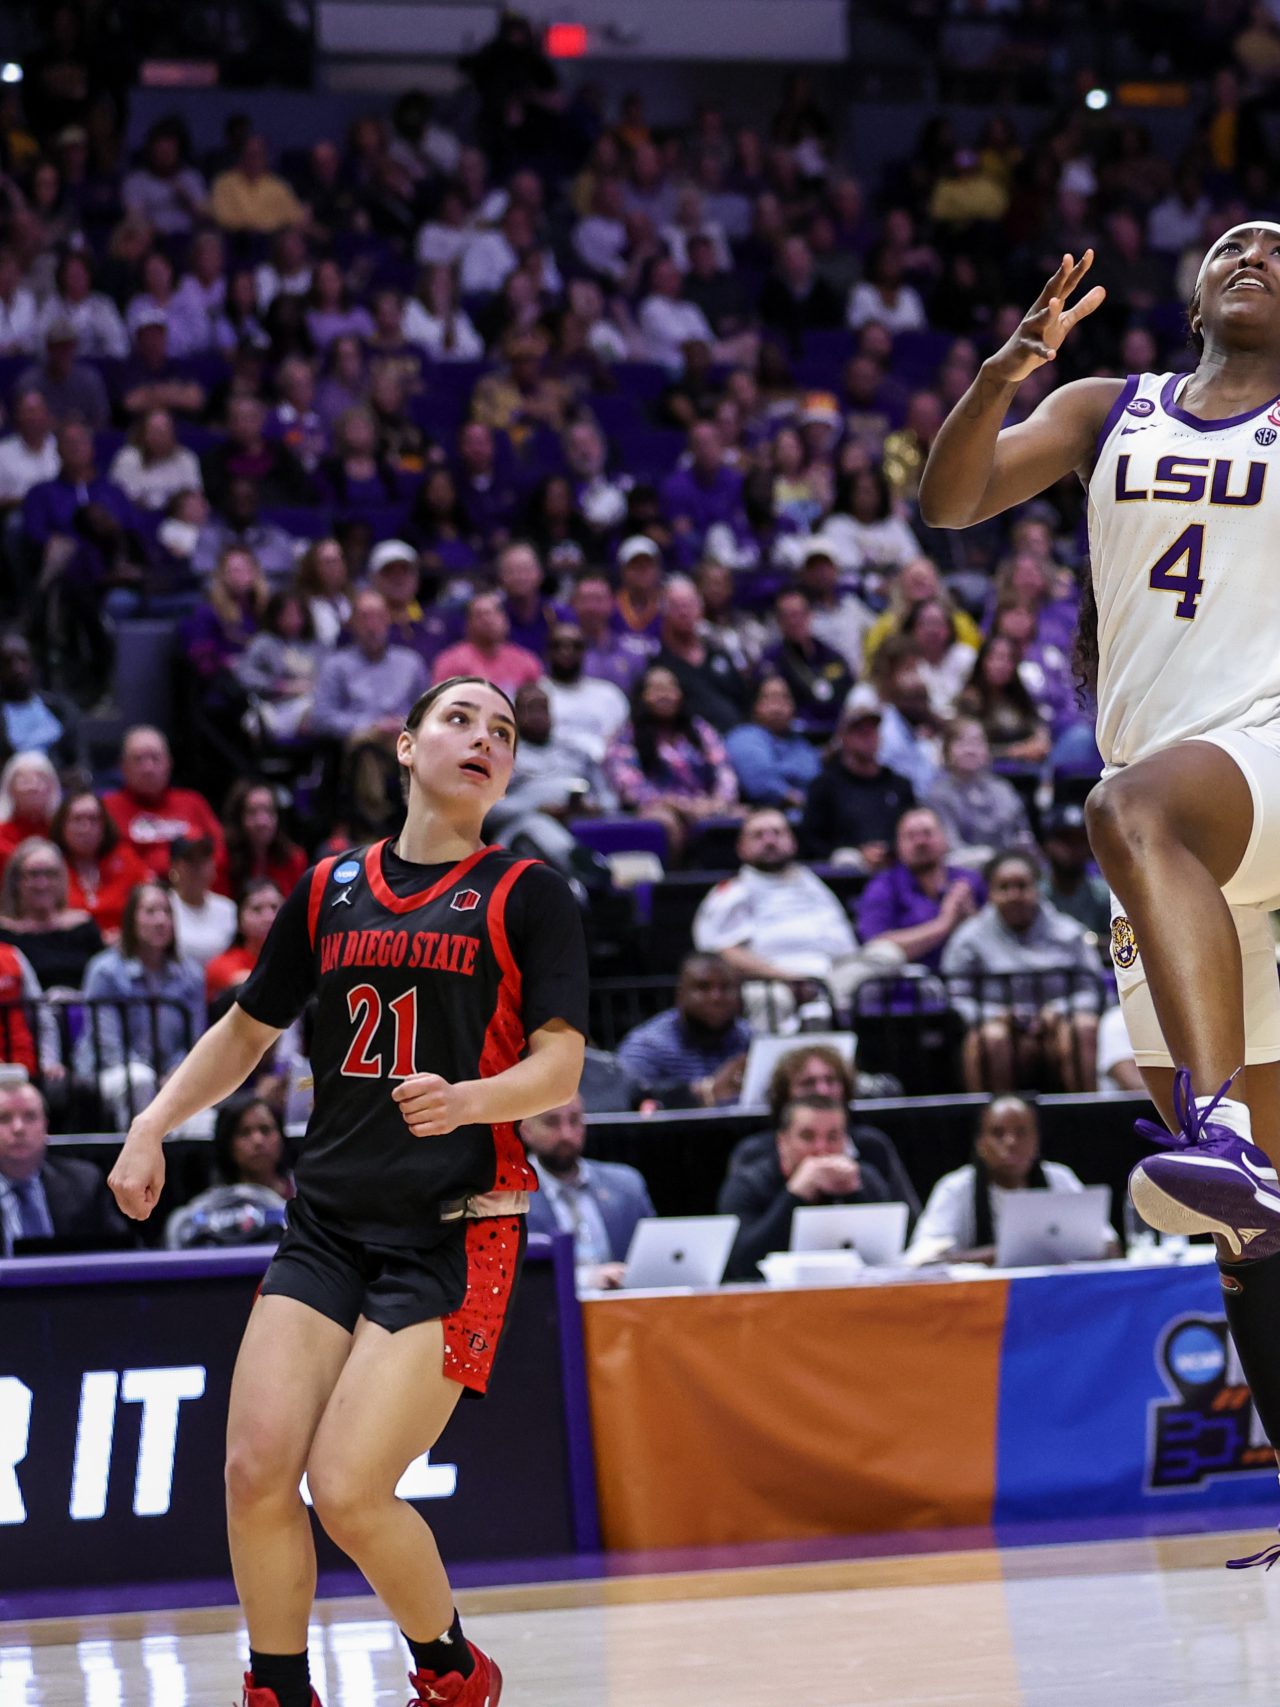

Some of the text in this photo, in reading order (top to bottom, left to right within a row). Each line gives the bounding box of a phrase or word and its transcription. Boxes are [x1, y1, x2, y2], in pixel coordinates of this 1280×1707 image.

[1256, 428, 1277, 445] SEC
[1115, 453, 1269, 508] LSU
[1148, 521, 1206, 621] 4
[341, 929, 409, 968] DIEGO
[407, 930, 481, 976] STATE
[340, 983, 418, 1080] 21
[69, 1365, 207, 1521] IT
